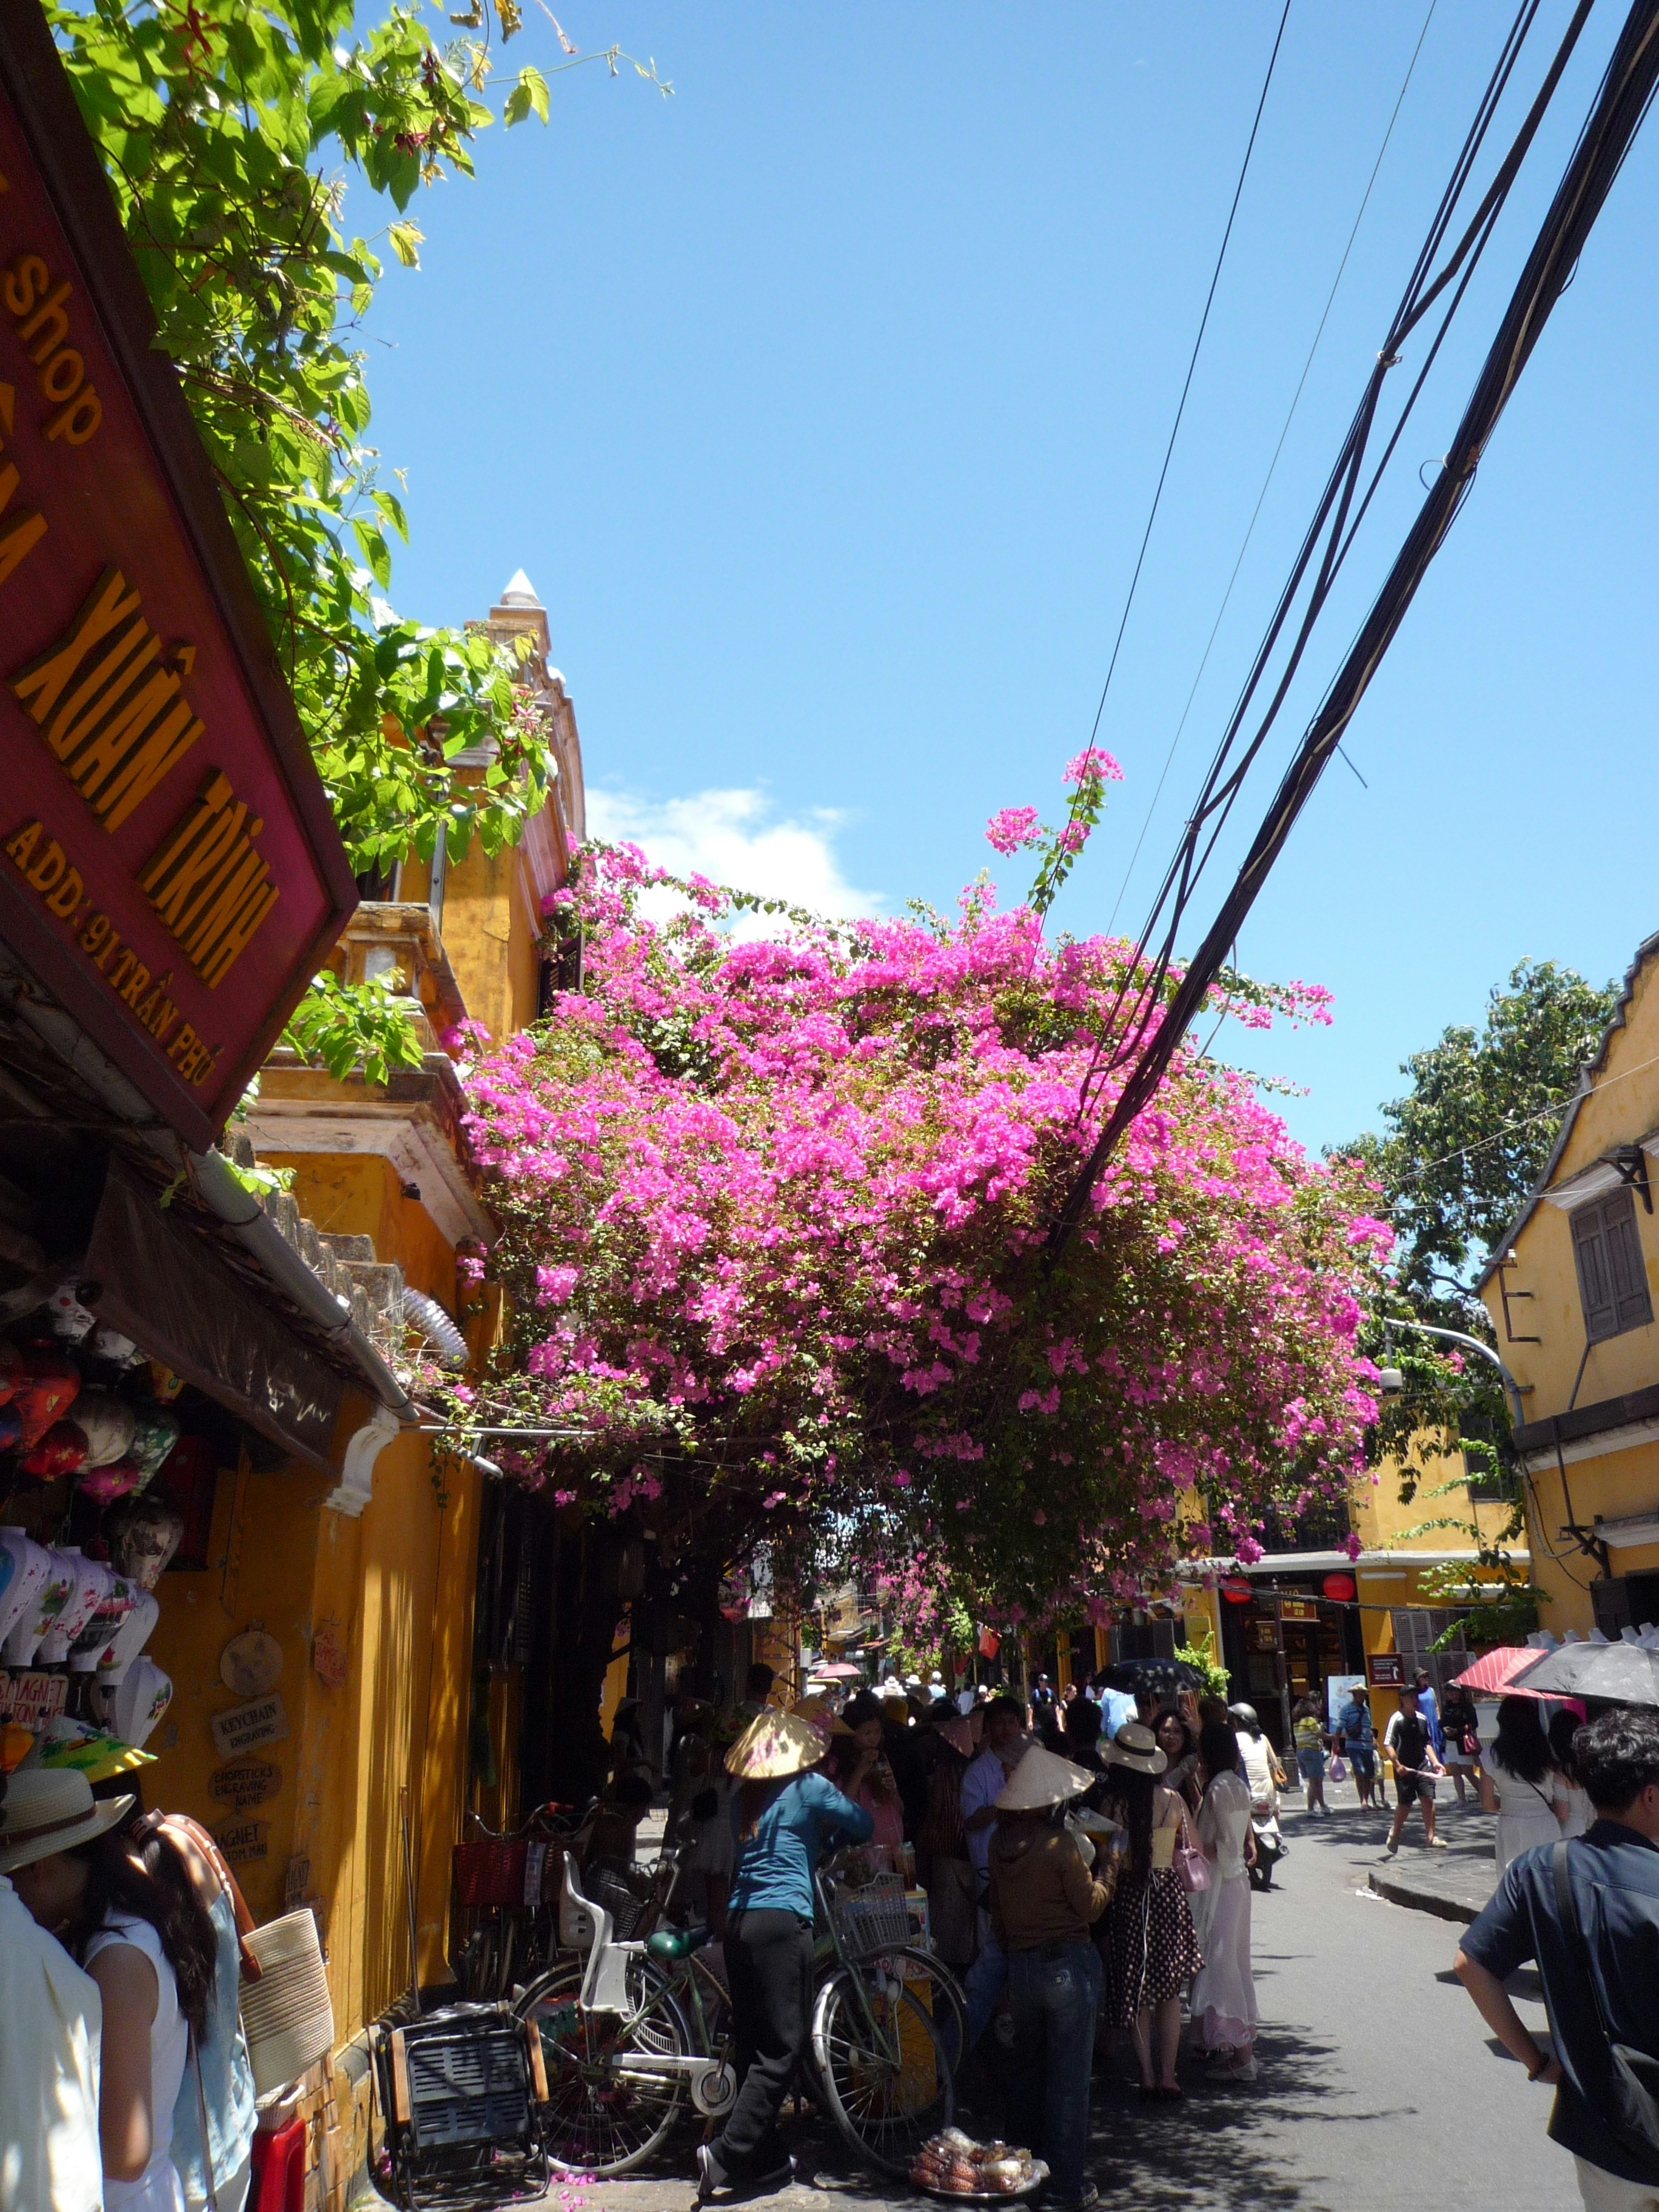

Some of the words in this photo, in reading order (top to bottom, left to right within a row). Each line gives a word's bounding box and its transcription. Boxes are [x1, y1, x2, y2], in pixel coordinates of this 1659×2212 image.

[3, 253, 103, 445] shop
[11, 568, 207, 835] XUÂN
[80, 913, 121, 970] 91
[166, 1022, 225, 1087] PHÚ
[5, 1677, 67, 1705] MAGNET
[220, 1701, 277, 1735] KEYCHAIN
[229, 1724, 276, 1749] ENGRAVING
[213, 1767, 273, 1783] CHOPSTICKS
[215, 1780, 267, 1797] ENGRAVING
[235, 1792, 264, 1807] NAME
[214, 1823, 260, 1849] AGNET
